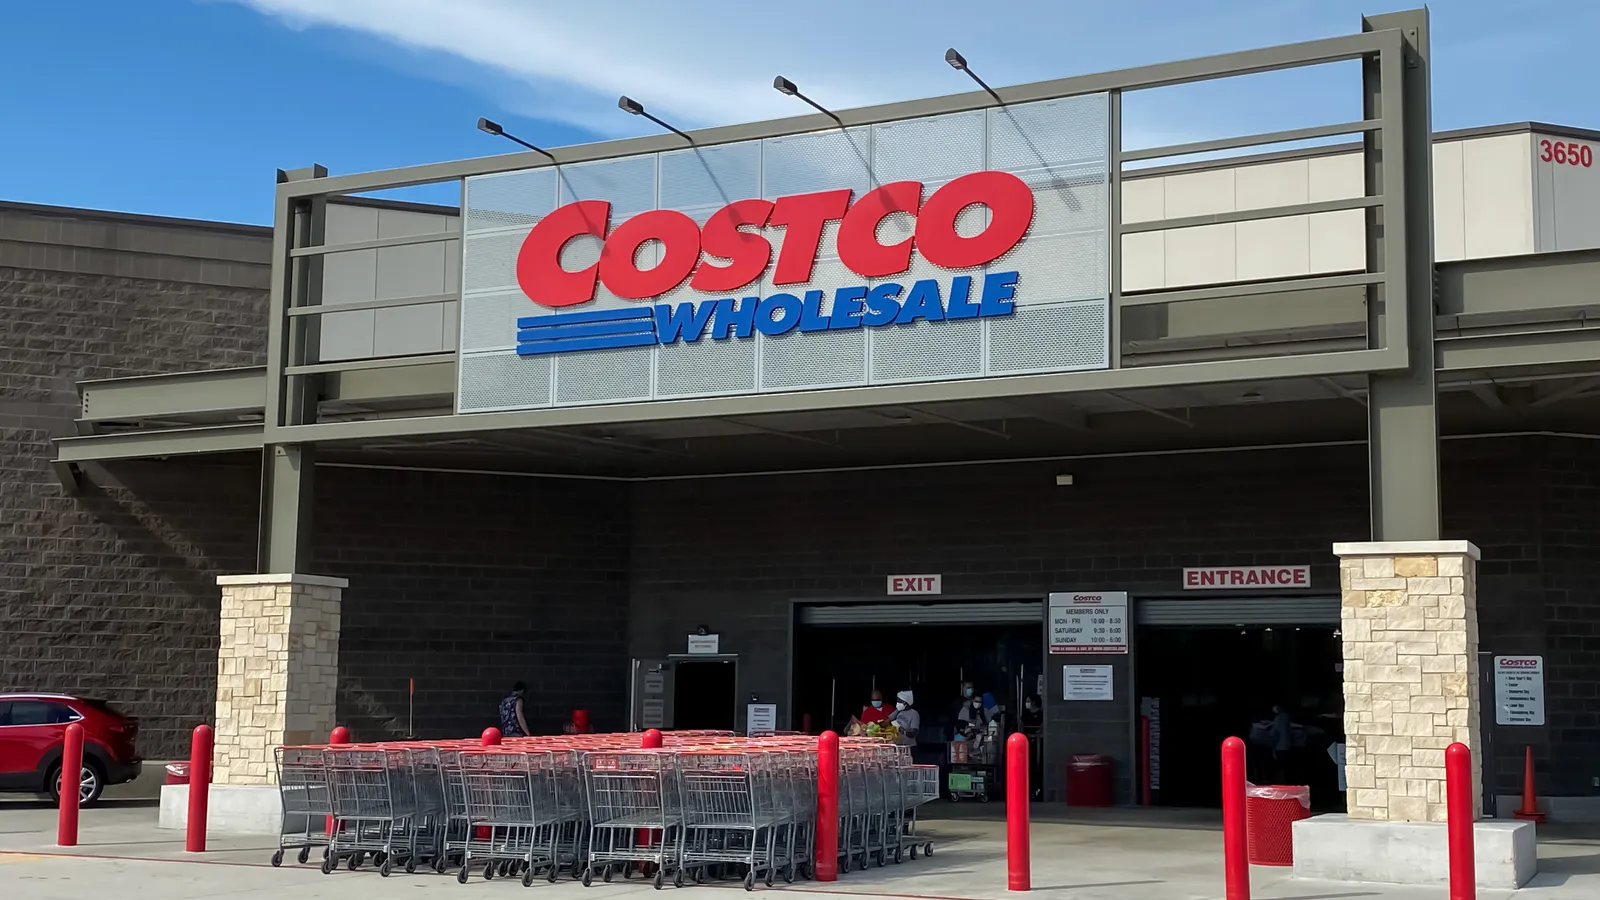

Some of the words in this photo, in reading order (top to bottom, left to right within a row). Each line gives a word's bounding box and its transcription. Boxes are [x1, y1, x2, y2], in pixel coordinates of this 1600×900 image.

[1540, 139, 1593, 168] 3650
[516, 170, 1034, 307] COSTCO
[655, 271, 1020, 345] WHOLESALE
[892, 577, 936, 592] EXIT
[1186, 568, 1306, 586] ENTRANCE
